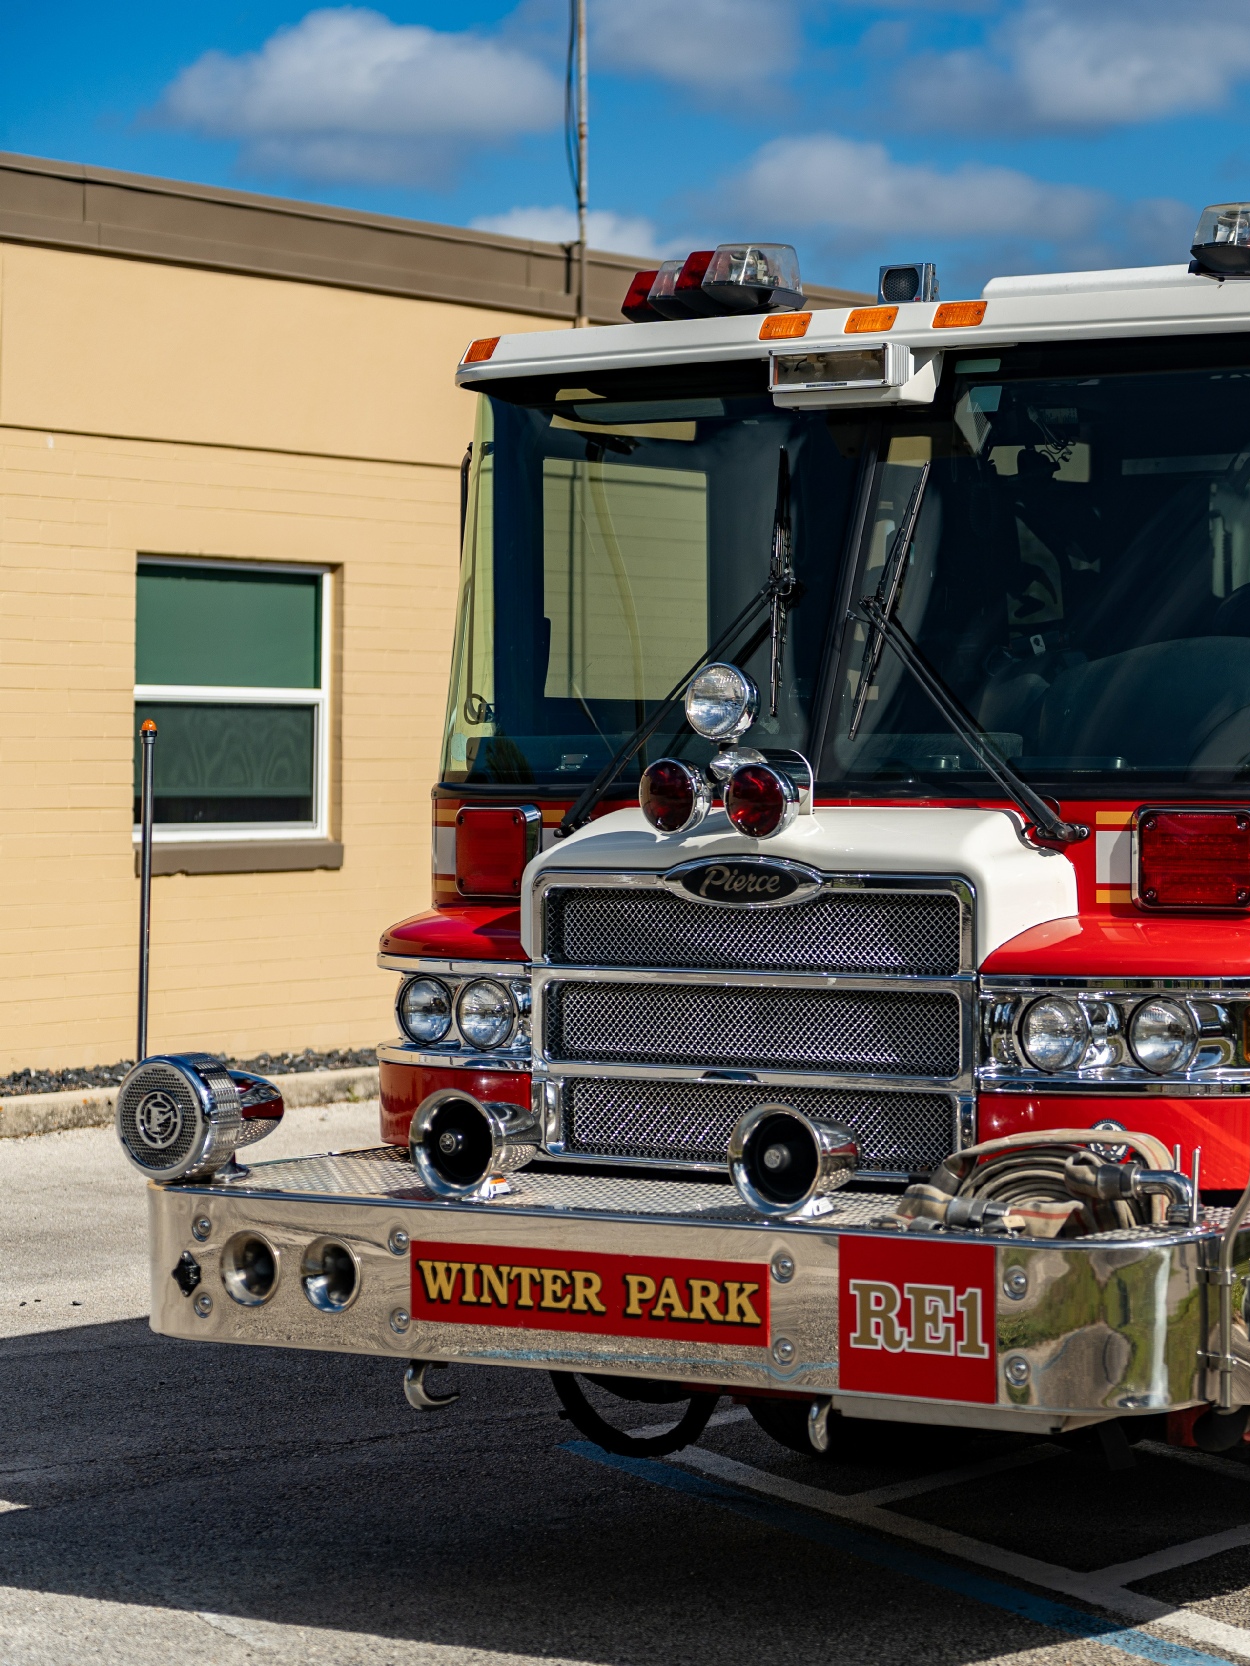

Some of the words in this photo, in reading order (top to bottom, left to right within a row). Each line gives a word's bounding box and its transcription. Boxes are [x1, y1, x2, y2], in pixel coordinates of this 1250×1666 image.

[699, 865, 781, 897] Pierce
[416, 1259, 606, 1314] WINTER
[624, 1273, 763, 1327] PARK
[849, 1279, 990, 1360] RE1
